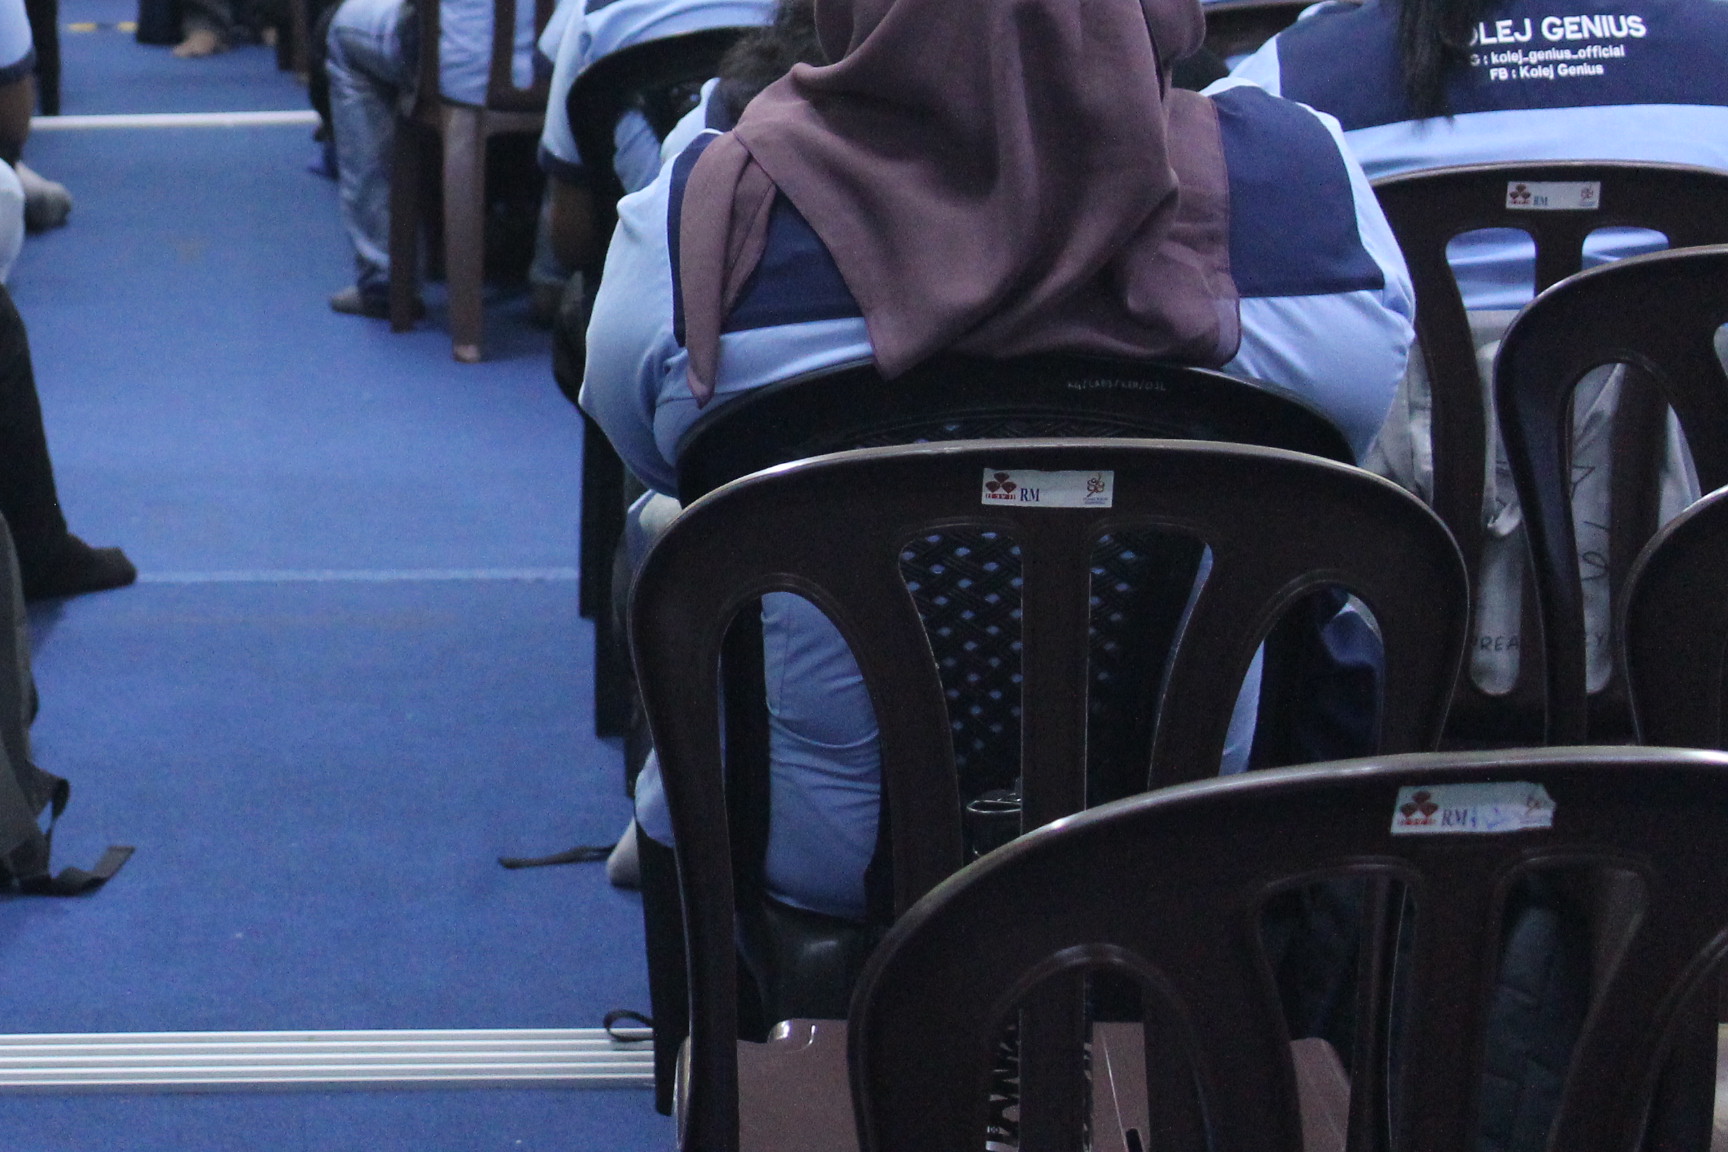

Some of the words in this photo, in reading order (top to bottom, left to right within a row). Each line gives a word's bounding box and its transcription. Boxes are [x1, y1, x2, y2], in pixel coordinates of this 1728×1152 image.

[1540, 14, 1648, 42] GENIUS
[1490, 44, 1626, 66] kolej_genius_official
[1489, 67, 1509, 81] FB
[1519, 65, 1556, 81] Kolej
[1557, 62, 1605, 77] Genius
[1020, 487, 1041, 502] RM
